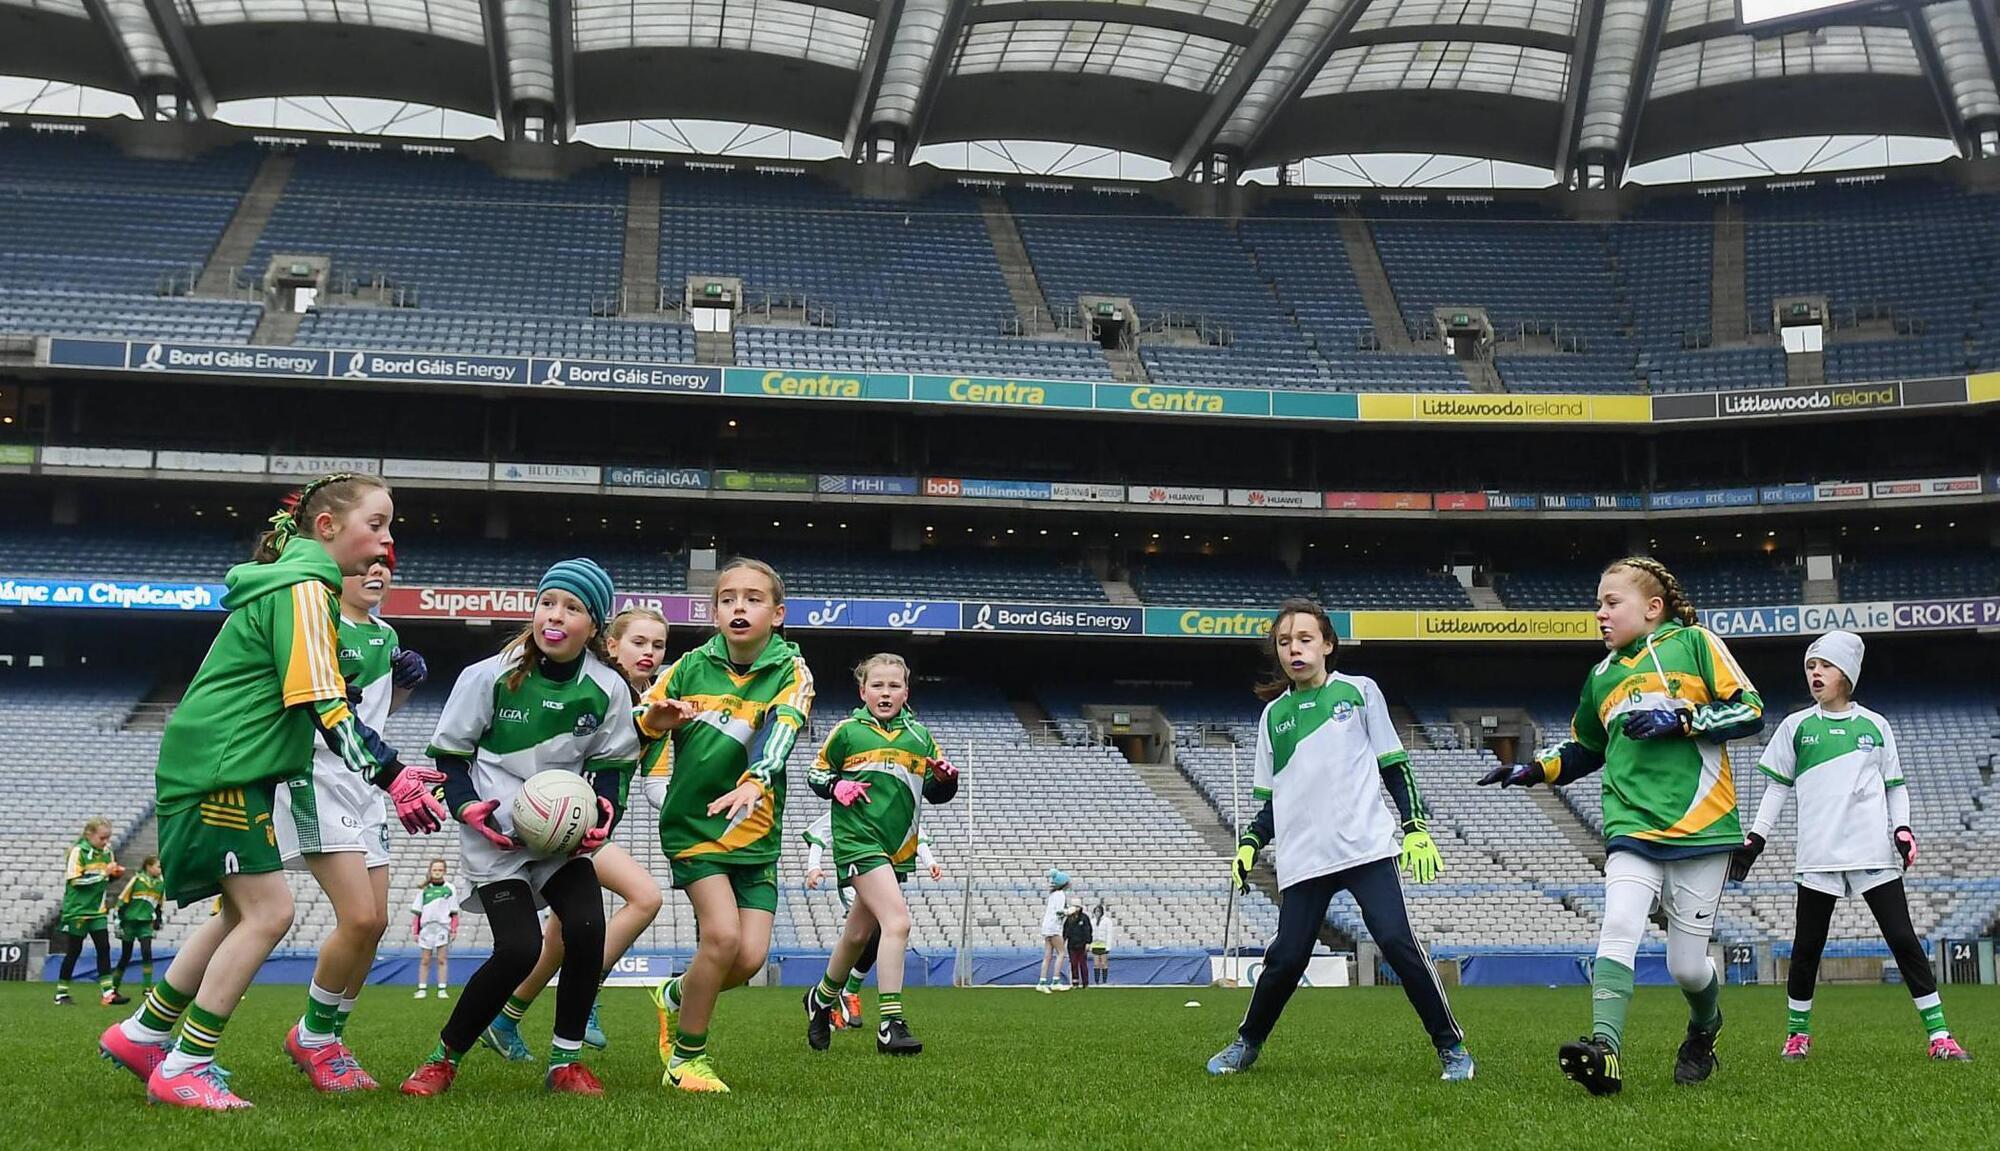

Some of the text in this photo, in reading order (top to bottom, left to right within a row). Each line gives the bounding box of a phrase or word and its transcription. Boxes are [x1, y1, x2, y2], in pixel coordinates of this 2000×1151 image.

[169, 349, 318, 374] Bord Gáis Energy
[371, 358, 517, 382] Bord Gáis Energy
[569, 367, 709, 390] Bord Gáis Energy
[761, 371, 860, 398] Centra
[949, 378, 1045, 405] Centra
[1130, 386, 1224, 412] Centra
[295, 457, 376, 473] ADMORE
[528, 465, 588, 479] BLUESKY
[612, 470, 701, 486] @officialGAA
[852, 479, 884, 491] MHI
[927, 480, 959, 495] bob
[961, 486, 1049, 498] mullanmotors
[1168, 493, 1205, 501] HUAWEI
[1267, 496, 1303, 504] HUAWEI
[52, 586, 84, 602] an
[419, 589, 537, 615] SuperValu
[808, 600, 847, 626] eir
[888, 603, 927, 627] eir
[998, 610, 1131, 630] Bord Gáis Energy
[1179, 610, 1272, 634] Centra
[1711, 609, 1796, 634] GAA.ie
[1804, 605, 1889, 630] GAA.ie
[1895, 602, 1976, 626] CROKE
[1628, 687, 1643, 706] 18
[719, 708, 732, 724] 8
[884, 757, 896, 770] 15
[0, 946, 21, 963] 19
[1732, 948, 1750, 964] 22
[1954, 945, 1971, 960] 24
